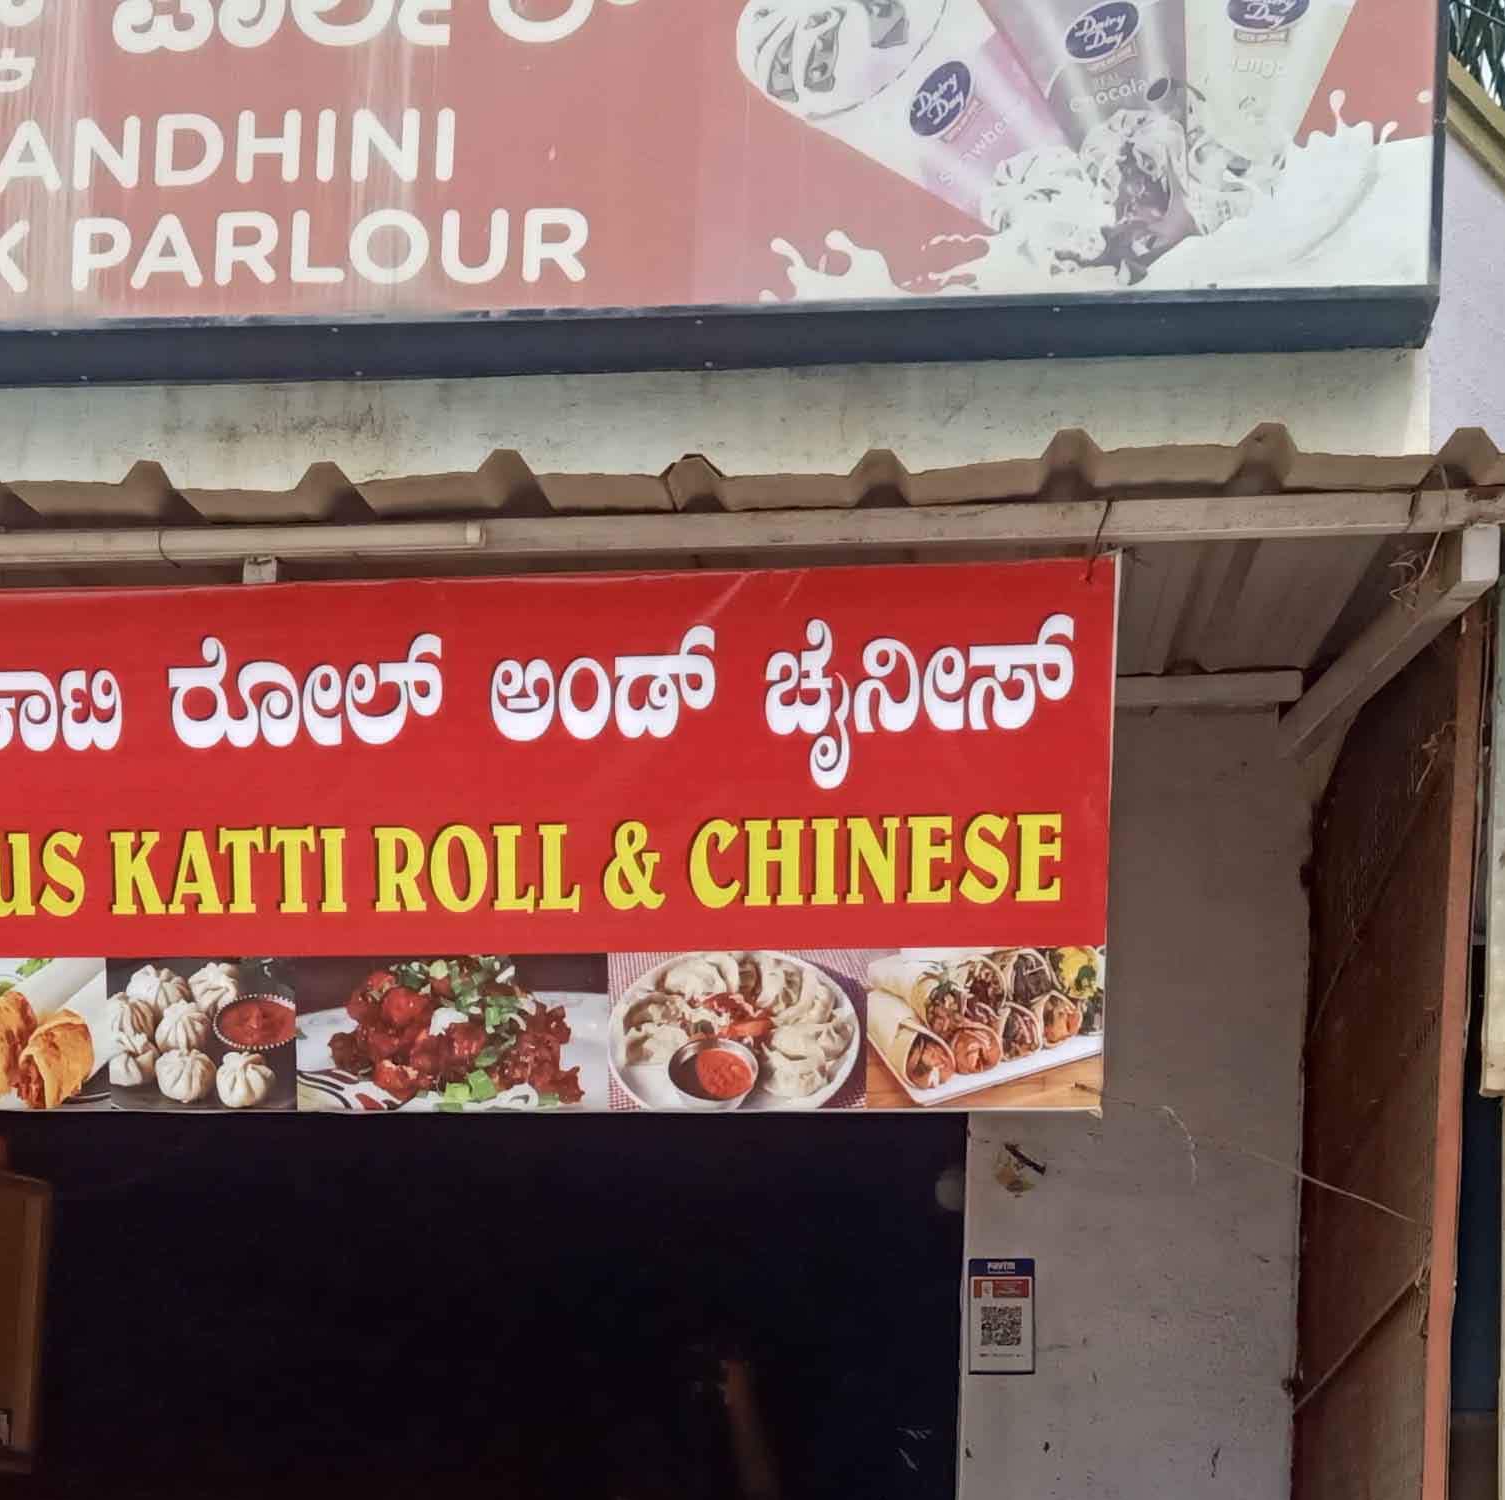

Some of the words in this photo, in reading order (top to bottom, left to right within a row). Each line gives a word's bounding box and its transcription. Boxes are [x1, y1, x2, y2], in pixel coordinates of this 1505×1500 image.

[1075, 14, 1126, 37] Dairy
[71, 208, 590, 291] PARLOUR
[167, 633, 444, 749] ರೋಲ್
[489, 625, 717, 741] ಅಂಡ್
[764, 614, 1075, 791] ಚೈನೀಸ್
[110, 827, 348, 916] KATTI
[373, 822, 580, 913] ROLL
[604, 820, 666, 911] &
[689, 813, 1063, 907] CHINESE
